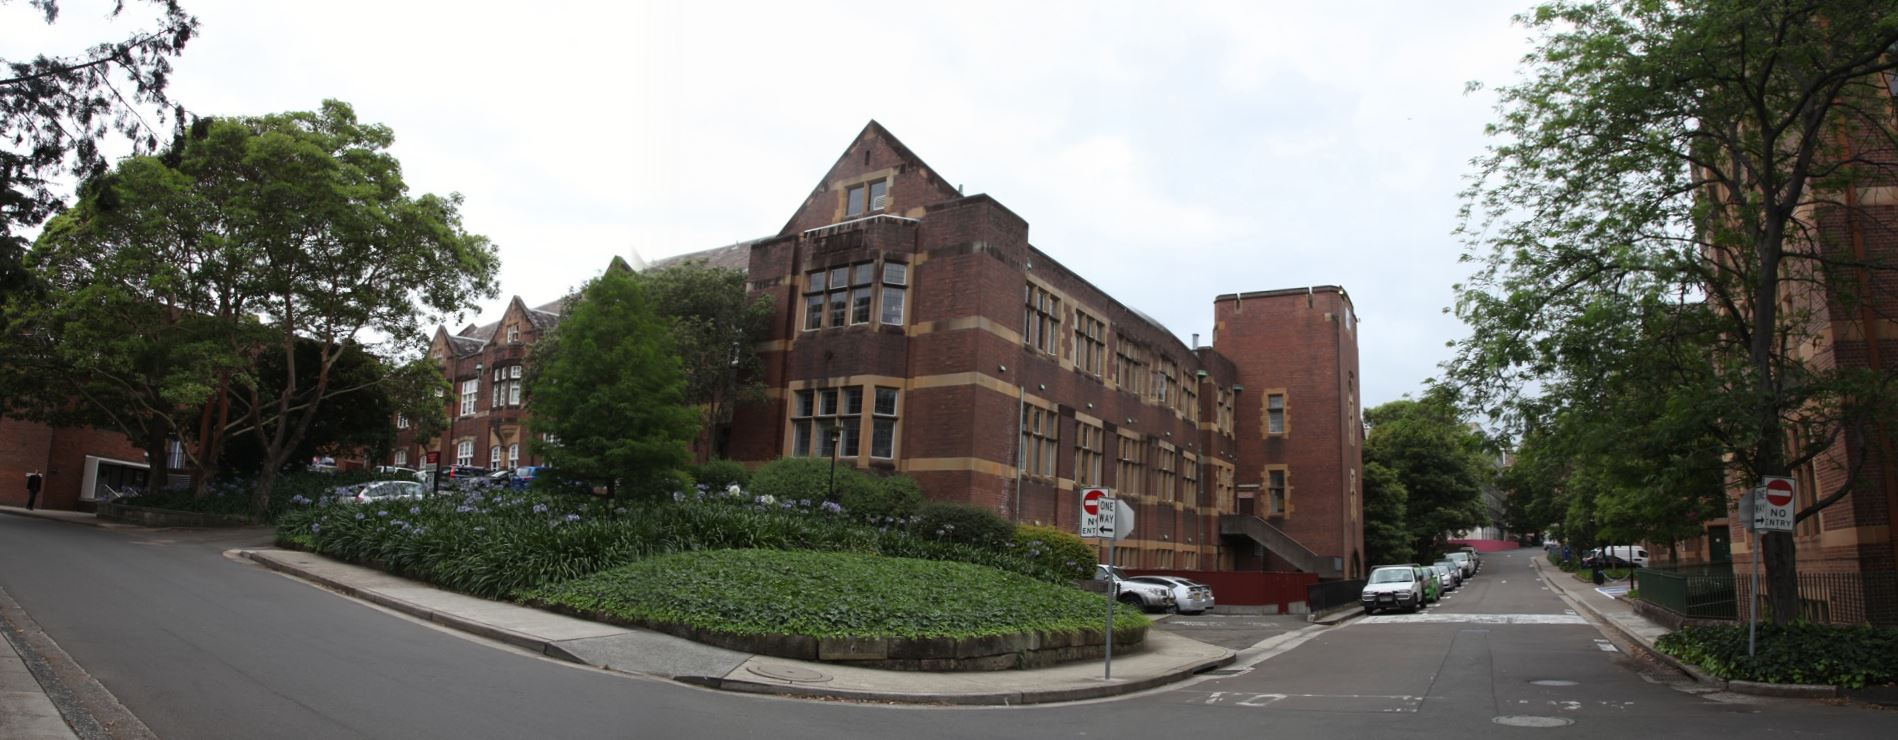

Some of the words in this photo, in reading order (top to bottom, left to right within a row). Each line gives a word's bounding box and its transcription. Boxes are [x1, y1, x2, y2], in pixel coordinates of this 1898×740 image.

[1100, 500, 1113, 512] ONE
[1770, 508, 1786, 518] NO
[1088, 517, 1097, 526] N
[1099, 513, 1114, 524] WAY
